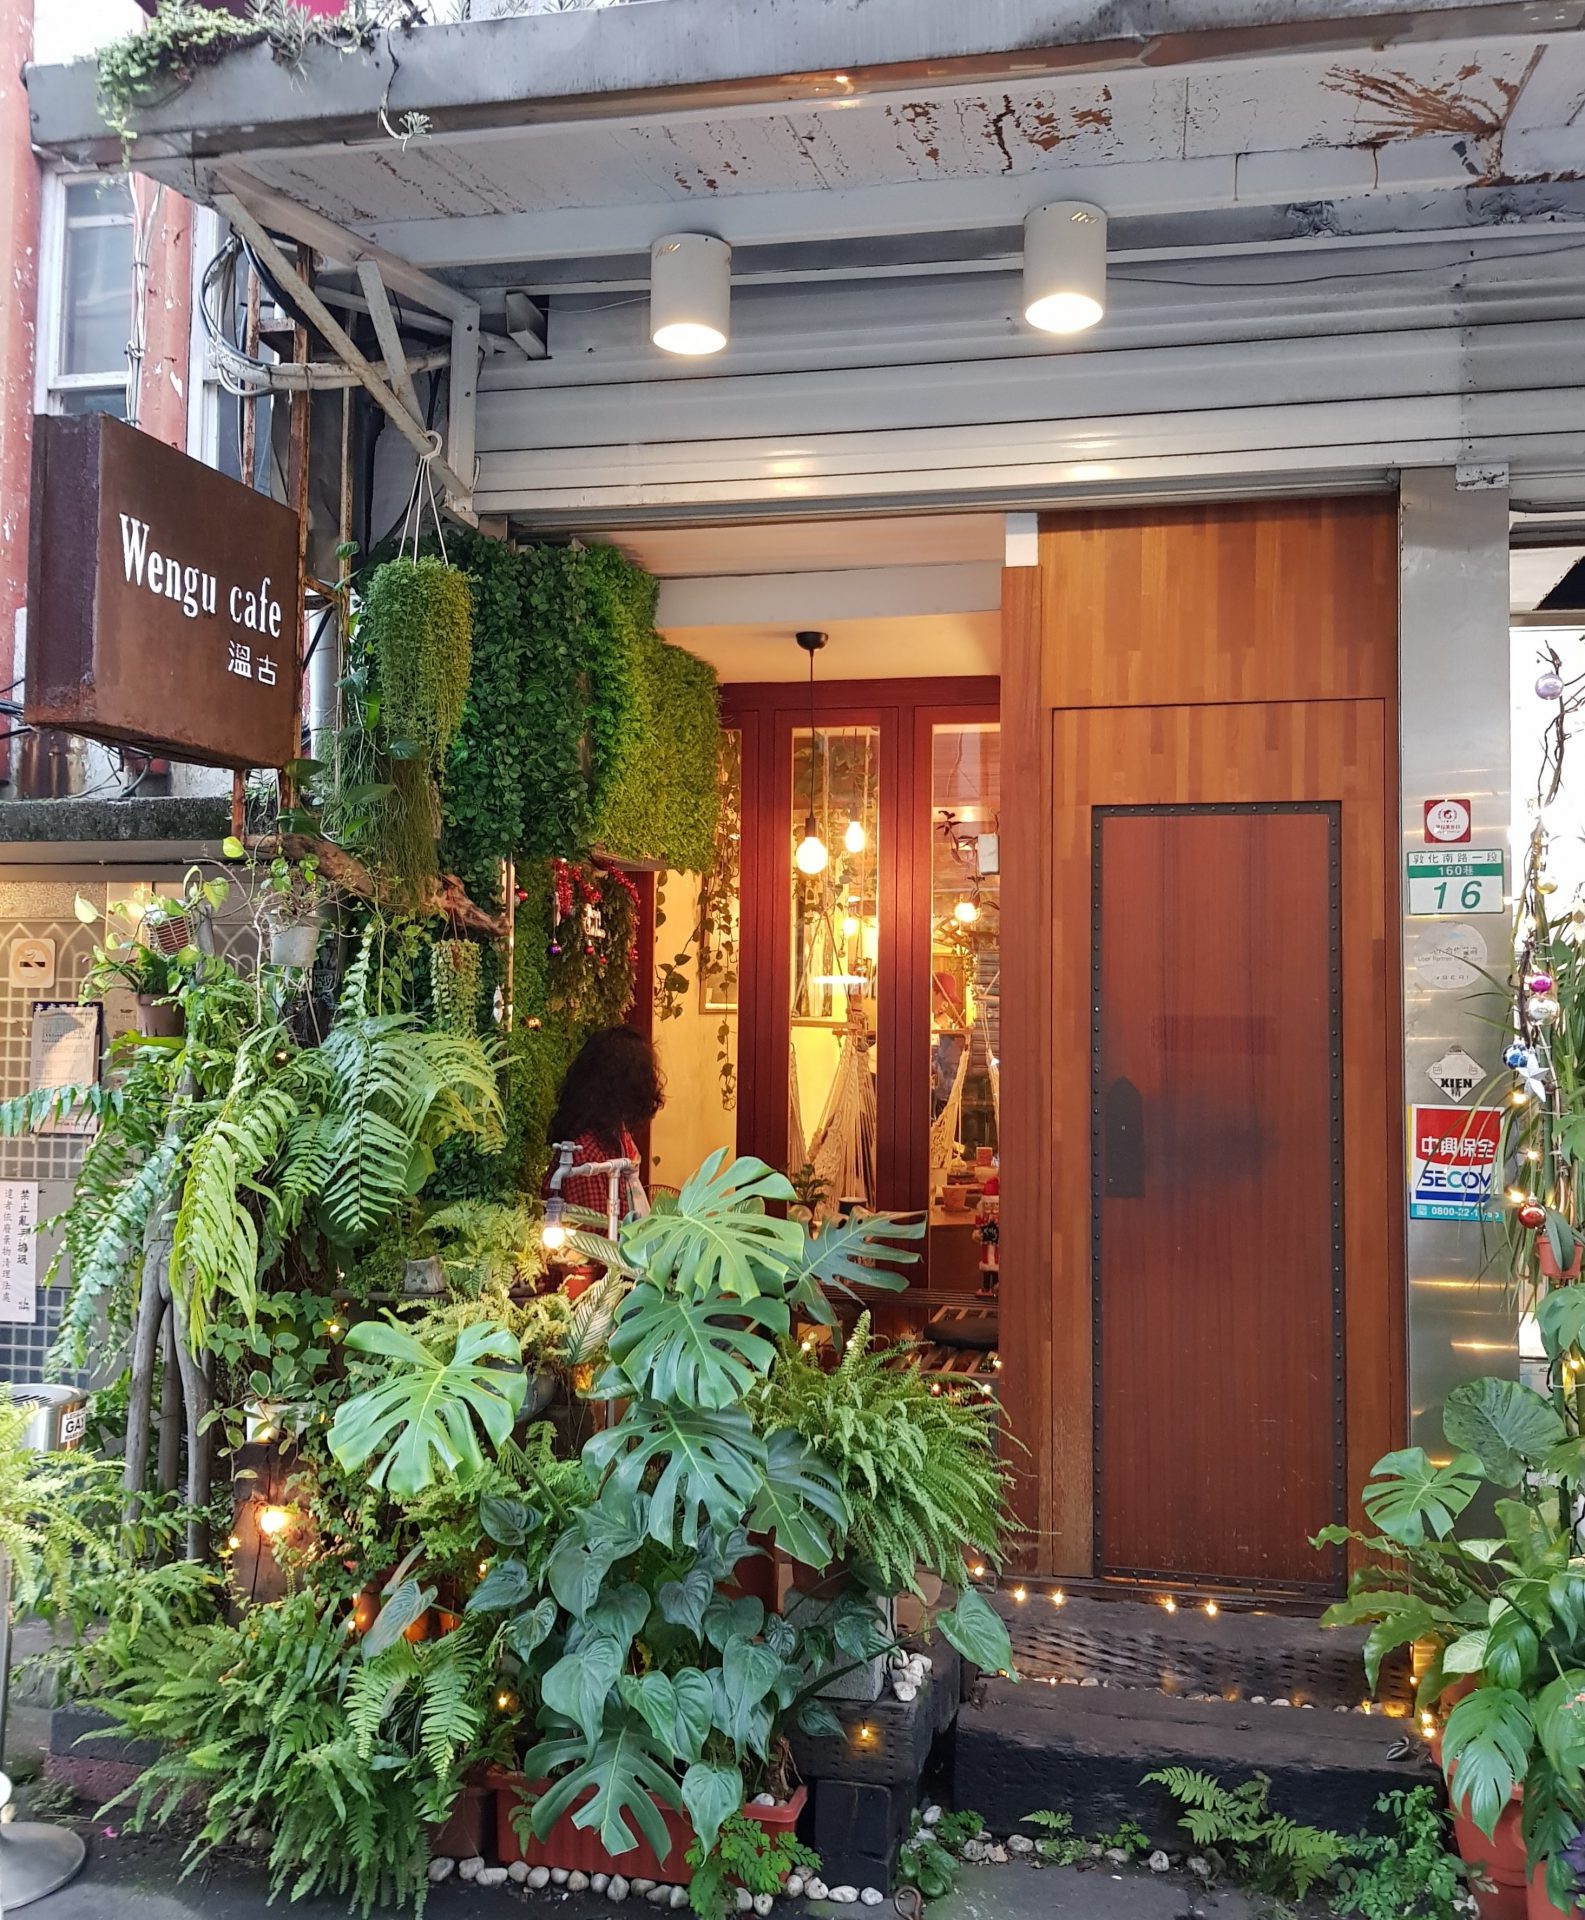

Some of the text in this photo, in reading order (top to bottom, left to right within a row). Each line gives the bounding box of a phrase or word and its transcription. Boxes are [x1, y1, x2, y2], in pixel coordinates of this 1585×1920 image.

[119, 512, 282, 638] Wengu cafe
[228, 639, 279, 686] 溫古
[1413, 852, 1498, 864] 敦化南路一段
[1438, 865, 1474, 876] 160巷
[1433, 880, 1482, 910] 16
[1440, 1078, 1472, 1088] XIEN
[1421, 1136, 1496, 1158] 中興保全
